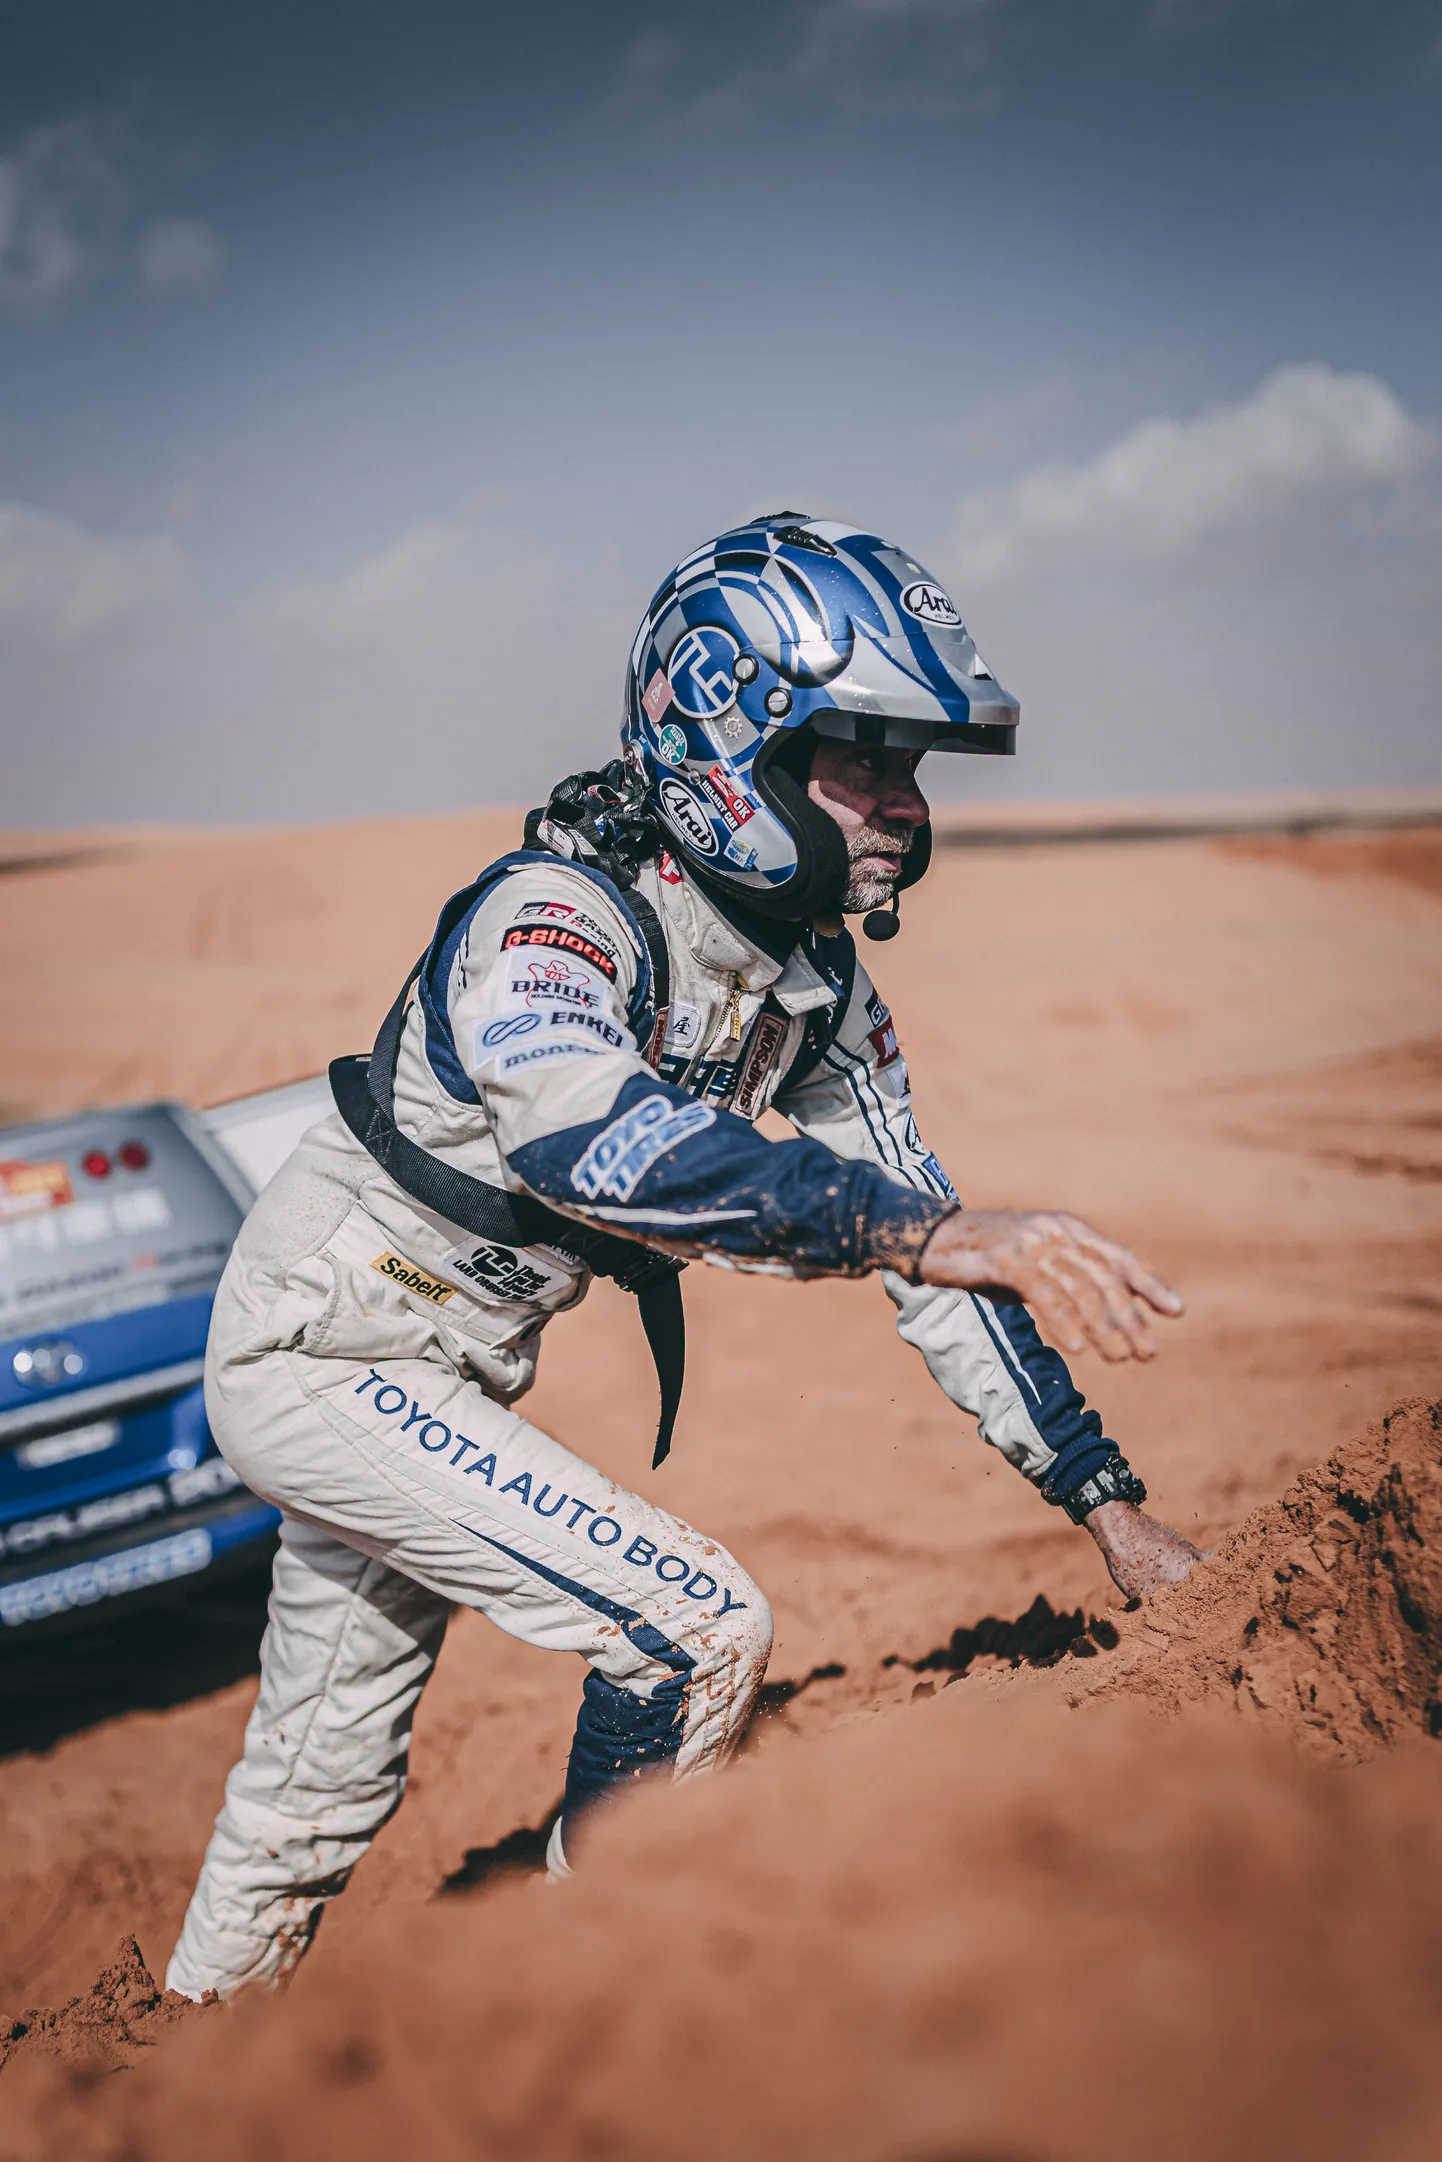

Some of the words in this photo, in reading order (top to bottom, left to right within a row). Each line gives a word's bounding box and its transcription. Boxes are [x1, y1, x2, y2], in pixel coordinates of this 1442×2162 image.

[663, 790, 712, 845] Arai
[702, 780, 727, 812] HELMET
[723, 811, 738, 830] CAR
[733, 798, 751, 819] OK
[505, 928, 615, 977] G-SHOCK
[512, 980, 600, 1008] BRIDE
[550, 1011, 623, 1048] ENKEI
[740, 1023, 779, 1109] SIMPSON
[380, 1257, 452, 1301] Sabelt
[452, 1259, 479, 1279] LAND
[354, 1368, 498, 1487] TOYOTA
[498, 1471, 622, 1547] AUTO
[622, 1535, 748, 1620] BODY
